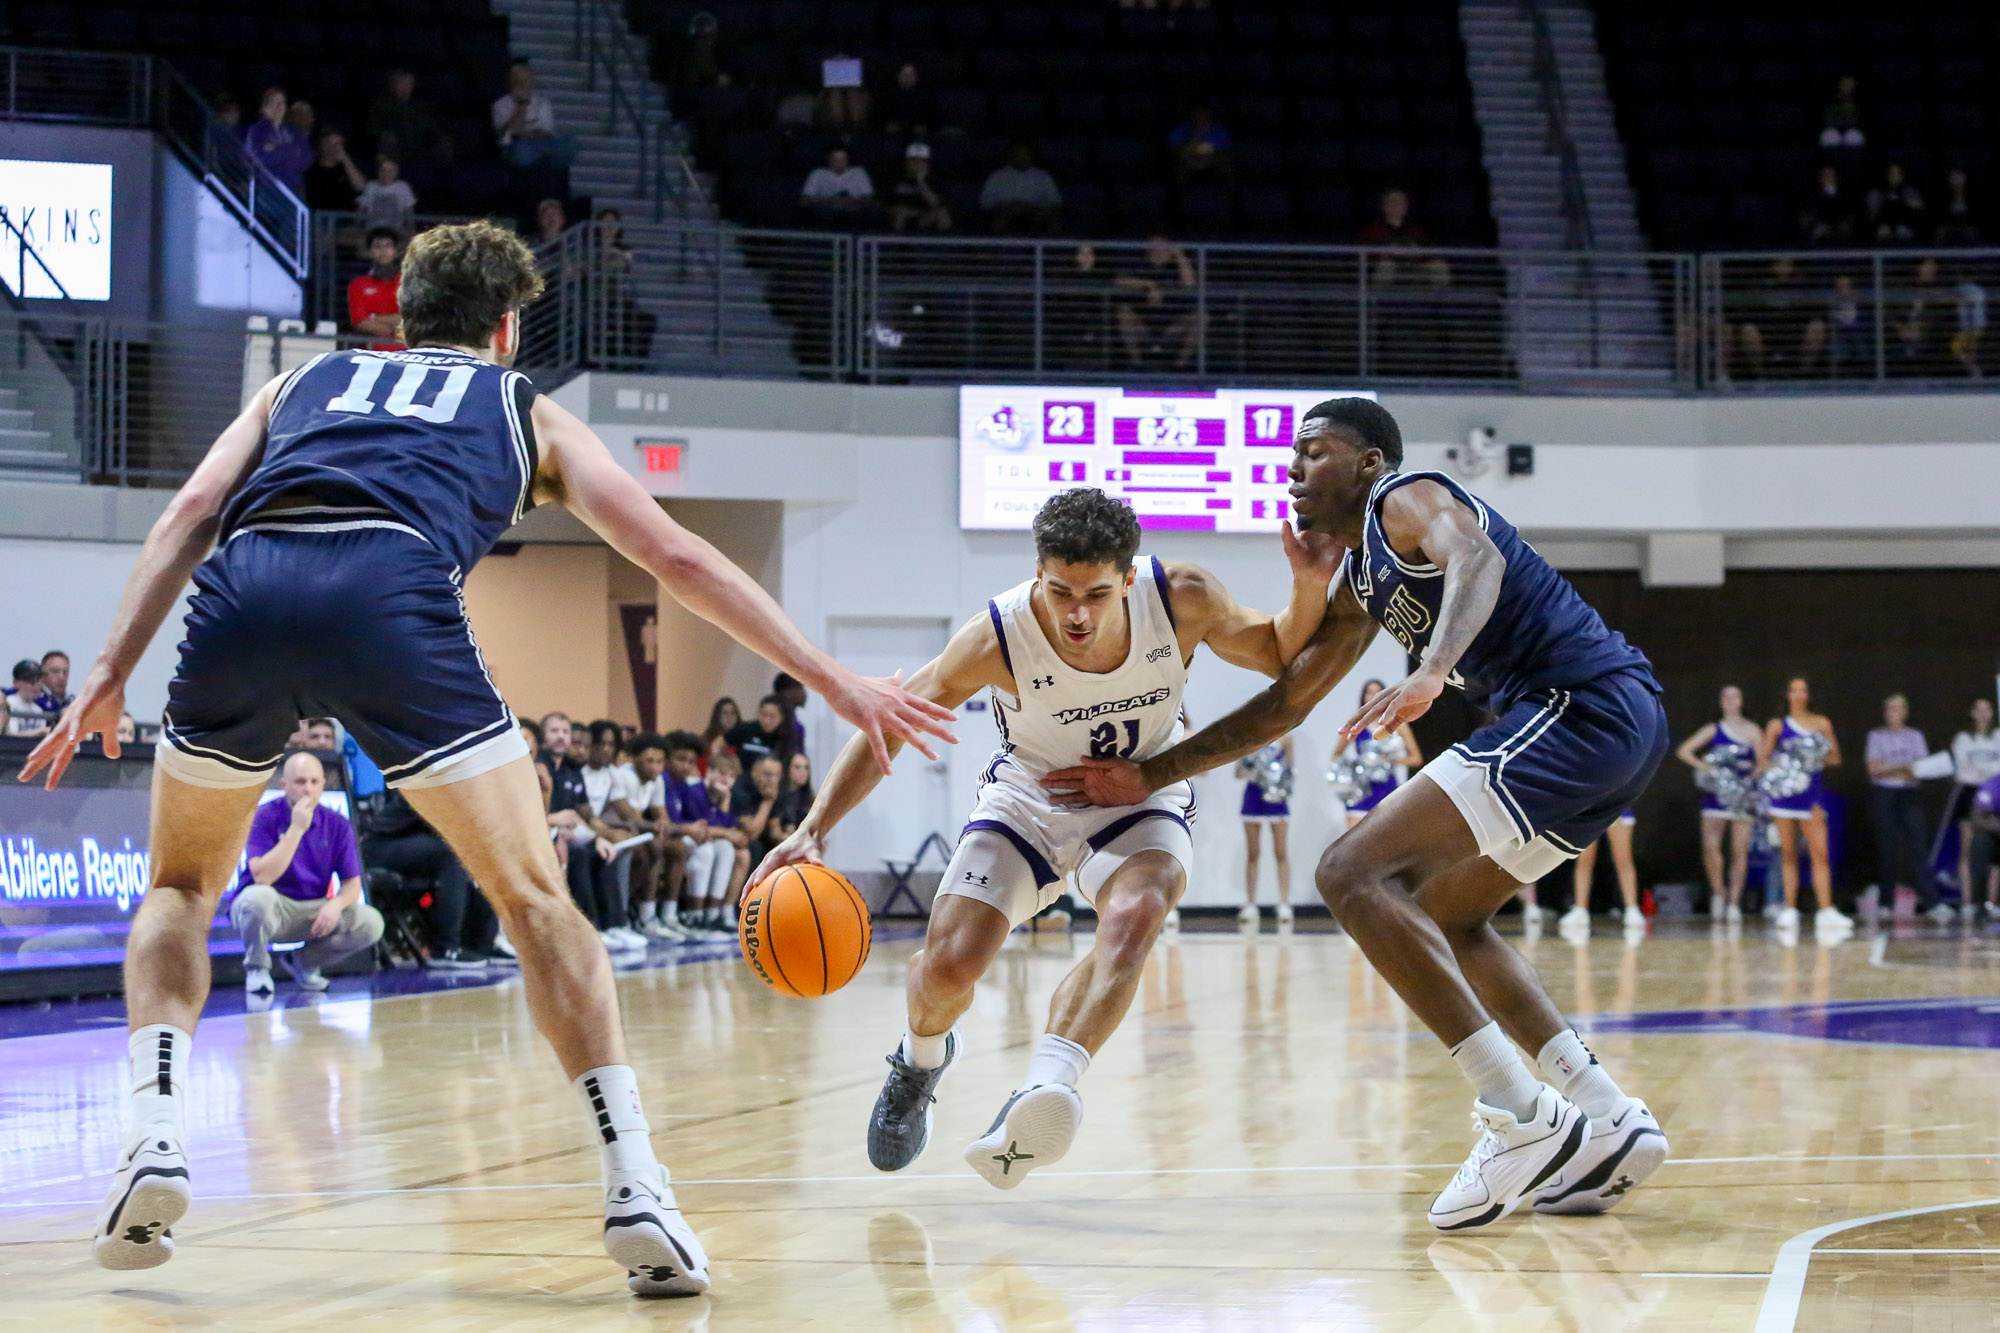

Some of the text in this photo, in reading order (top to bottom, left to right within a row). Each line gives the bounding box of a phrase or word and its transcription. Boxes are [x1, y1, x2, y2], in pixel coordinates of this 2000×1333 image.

[0, 205, 101, 245] KINS
[325, 355, 478, 424] 10
[1048, 406, 1086, 437] 23
[1137, 417, 1199, 446] 6:25
[1252, 408, 1282, 440] 17
[646, 446, 681, 472] EXIT
[1052, 688, 1170, 725] WILDCATS
[1090, 719, 1140, 758] 21
[0, 837, 79, 899] Abilene
